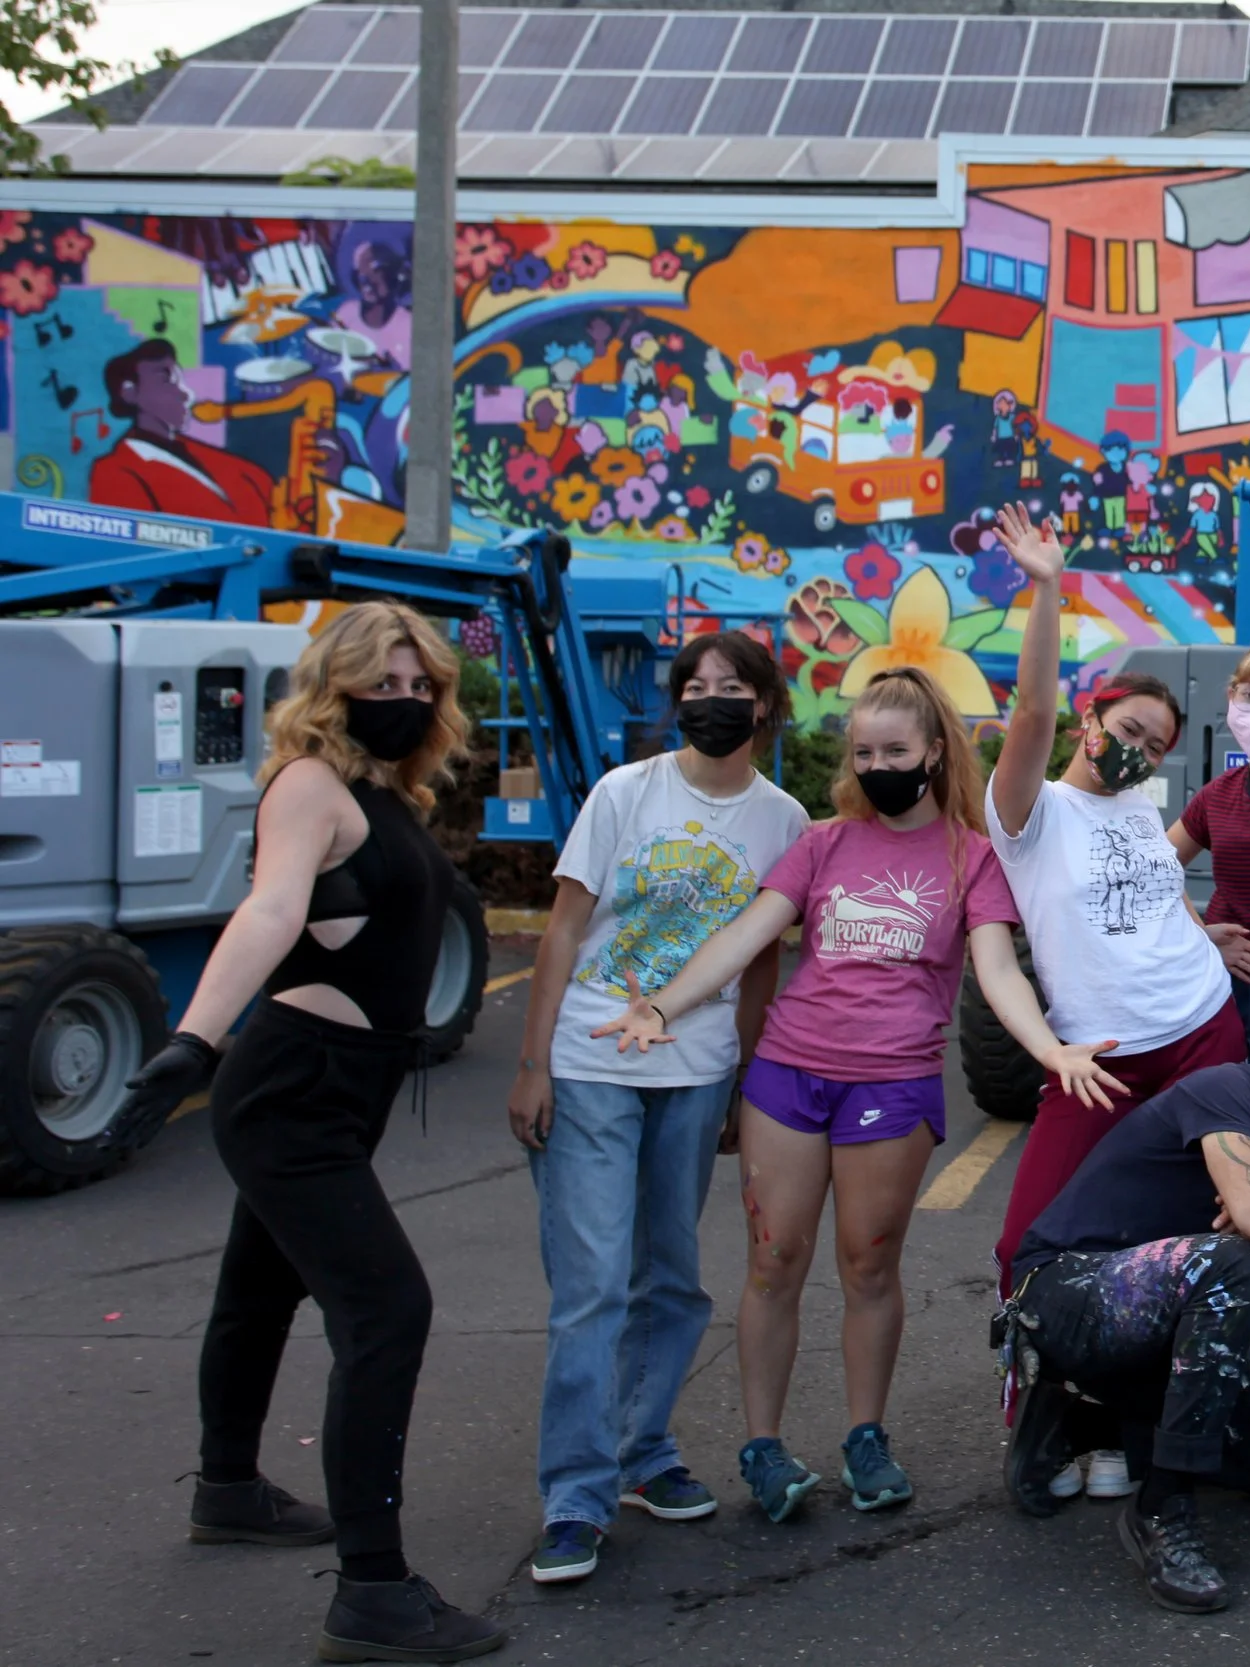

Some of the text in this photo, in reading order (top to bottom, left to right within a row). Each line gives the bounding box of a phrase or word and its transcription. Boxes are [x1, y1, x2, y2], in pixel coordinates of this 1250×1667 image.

[28, 504, 209, 548] INTERSTATE RENTALS
[835, 921, 925, 954] PORTLAND
